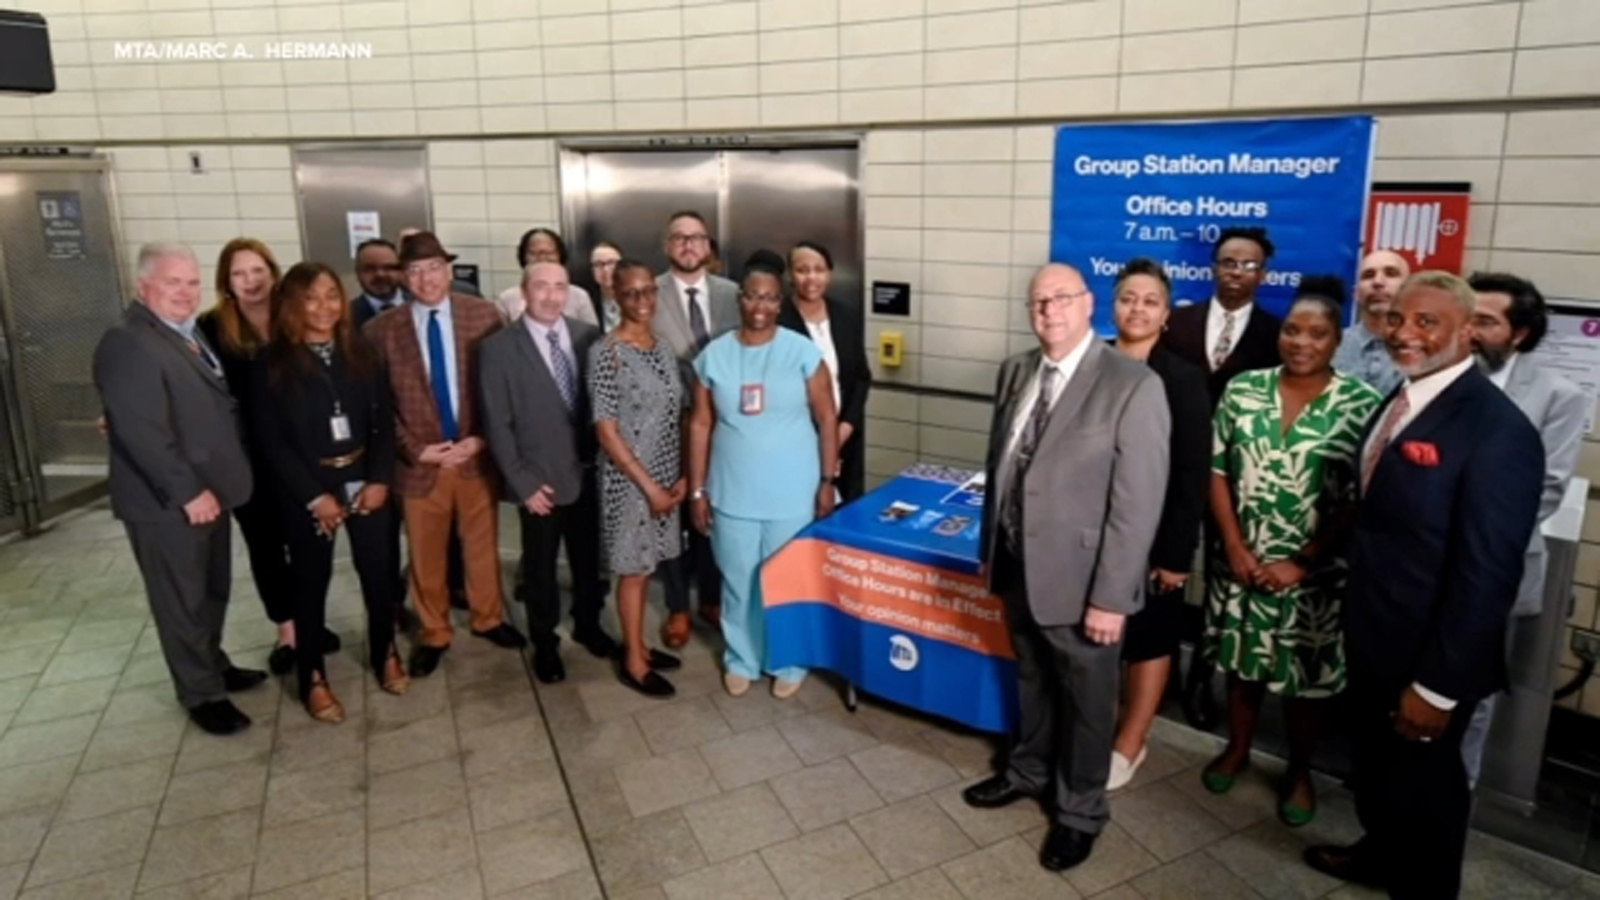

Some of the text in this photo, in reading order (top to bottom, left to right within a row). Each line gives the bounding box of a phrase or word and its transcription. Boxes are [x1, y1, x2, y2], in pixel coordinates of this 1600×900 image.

[1074, 154, 1340, 178] Group Station Manager
[1125, 196, 1267, 217] Office Hours
[1124, 222, 1137, 240] 7
[1197, 223, 1221, 244] 10
[1588, 322, 1598, 334] 7
[826, 547, 868, 572] Group
[870, 558, 923, 583] Station
[822, 563, 859, 588] Office
[861, 575, 906, 598] Hours
[909, 589, 933, 606] are
[837, 592, 865, 613] Your
[867, 604, 920, 628] opinion
